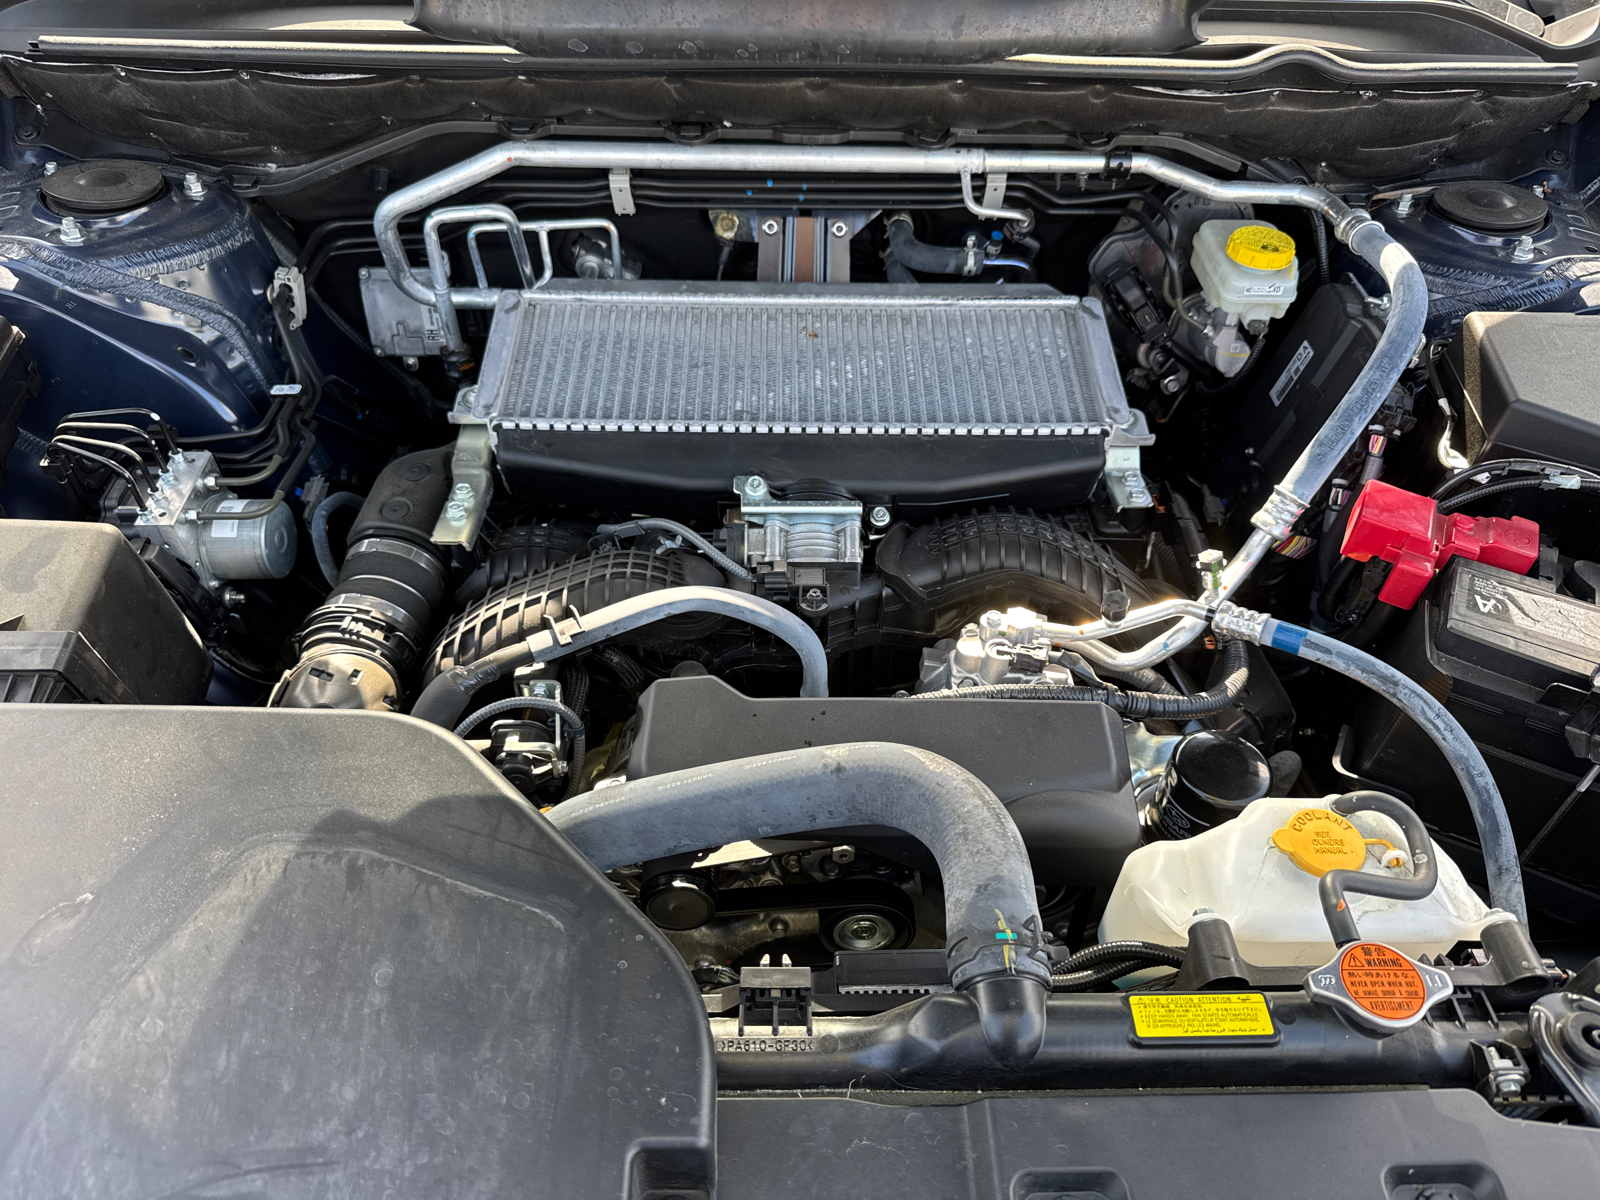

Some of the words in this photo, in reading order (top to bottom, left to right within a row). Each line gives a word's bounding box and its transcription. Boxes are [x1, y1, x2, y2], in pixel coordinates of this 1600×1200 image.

[1292, 811, 1352, 832] COOLANT
[1314, 846, 1348, 854] MANUAL
[1364, 958, 1402, 968] WARNING
[721, 1040, 812, 1052] >PA610-GF30<
